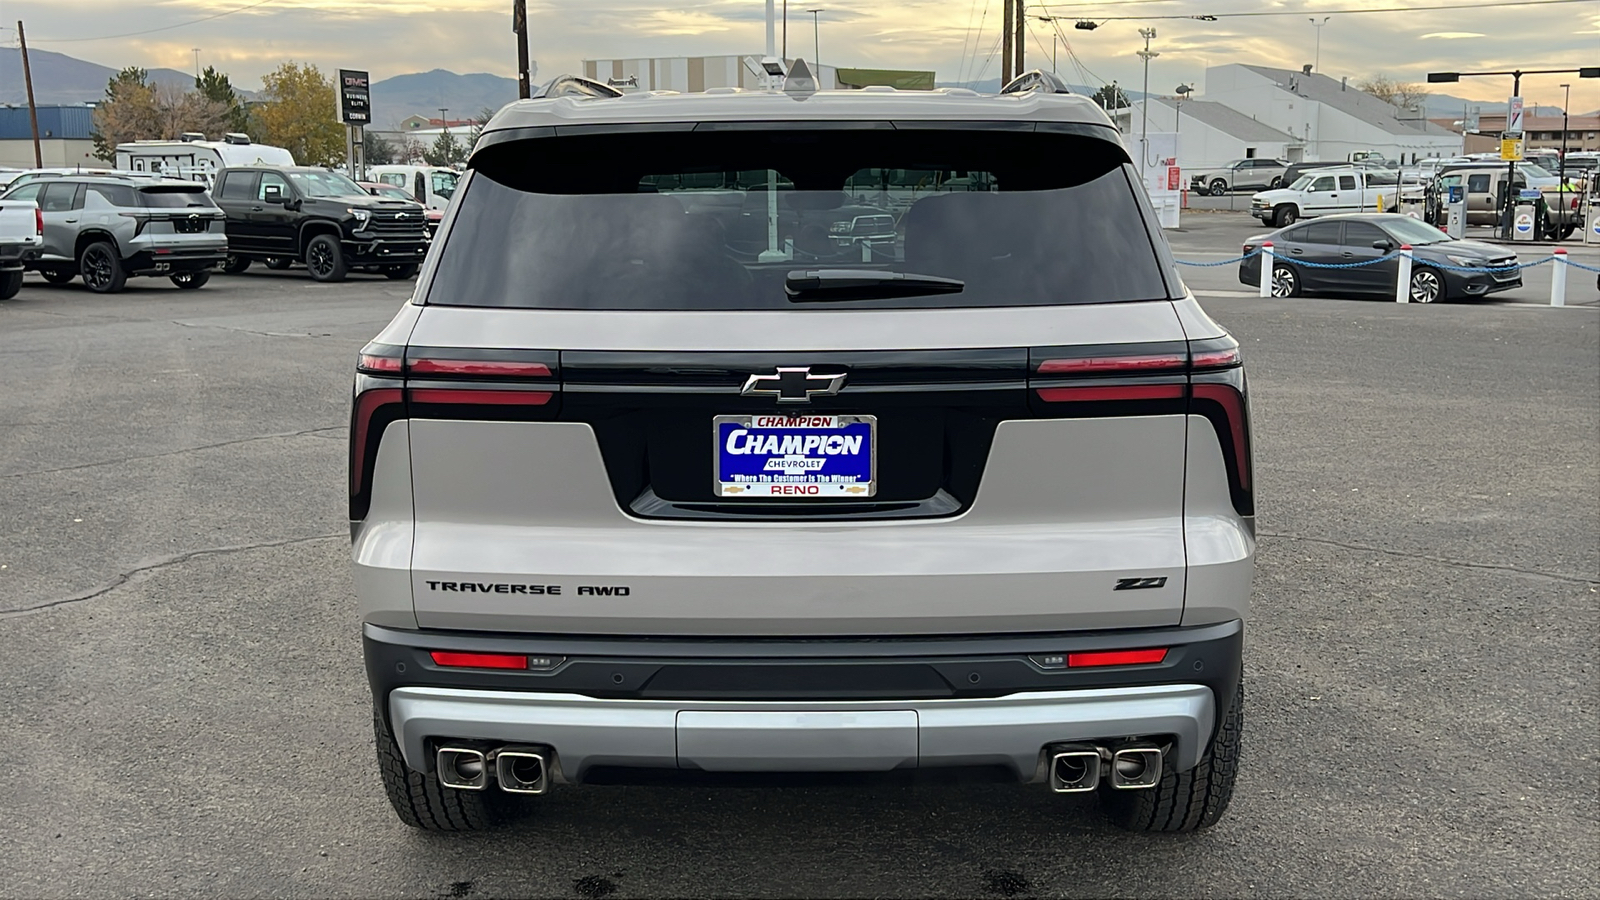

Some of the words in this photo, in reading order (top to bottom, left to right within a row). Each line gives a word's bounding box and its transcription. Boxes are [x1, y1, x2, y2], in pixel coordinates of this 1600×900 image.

[344, 77, 367, 86] GMC
[757, 416, 832, 427] CHAMPION
[768, 460, 821, 468] CHEVROLET
[759, 474, 772, 482] The
[773, 474, 807, 482] Customer
[808, 474, 816, 482] Is
[816, 474, 830, 482] The
[771, 485, 819, 494] RENO
[425, 581, 562, 595] TRAVERSE
[577, 586, 630, 596] AWD
